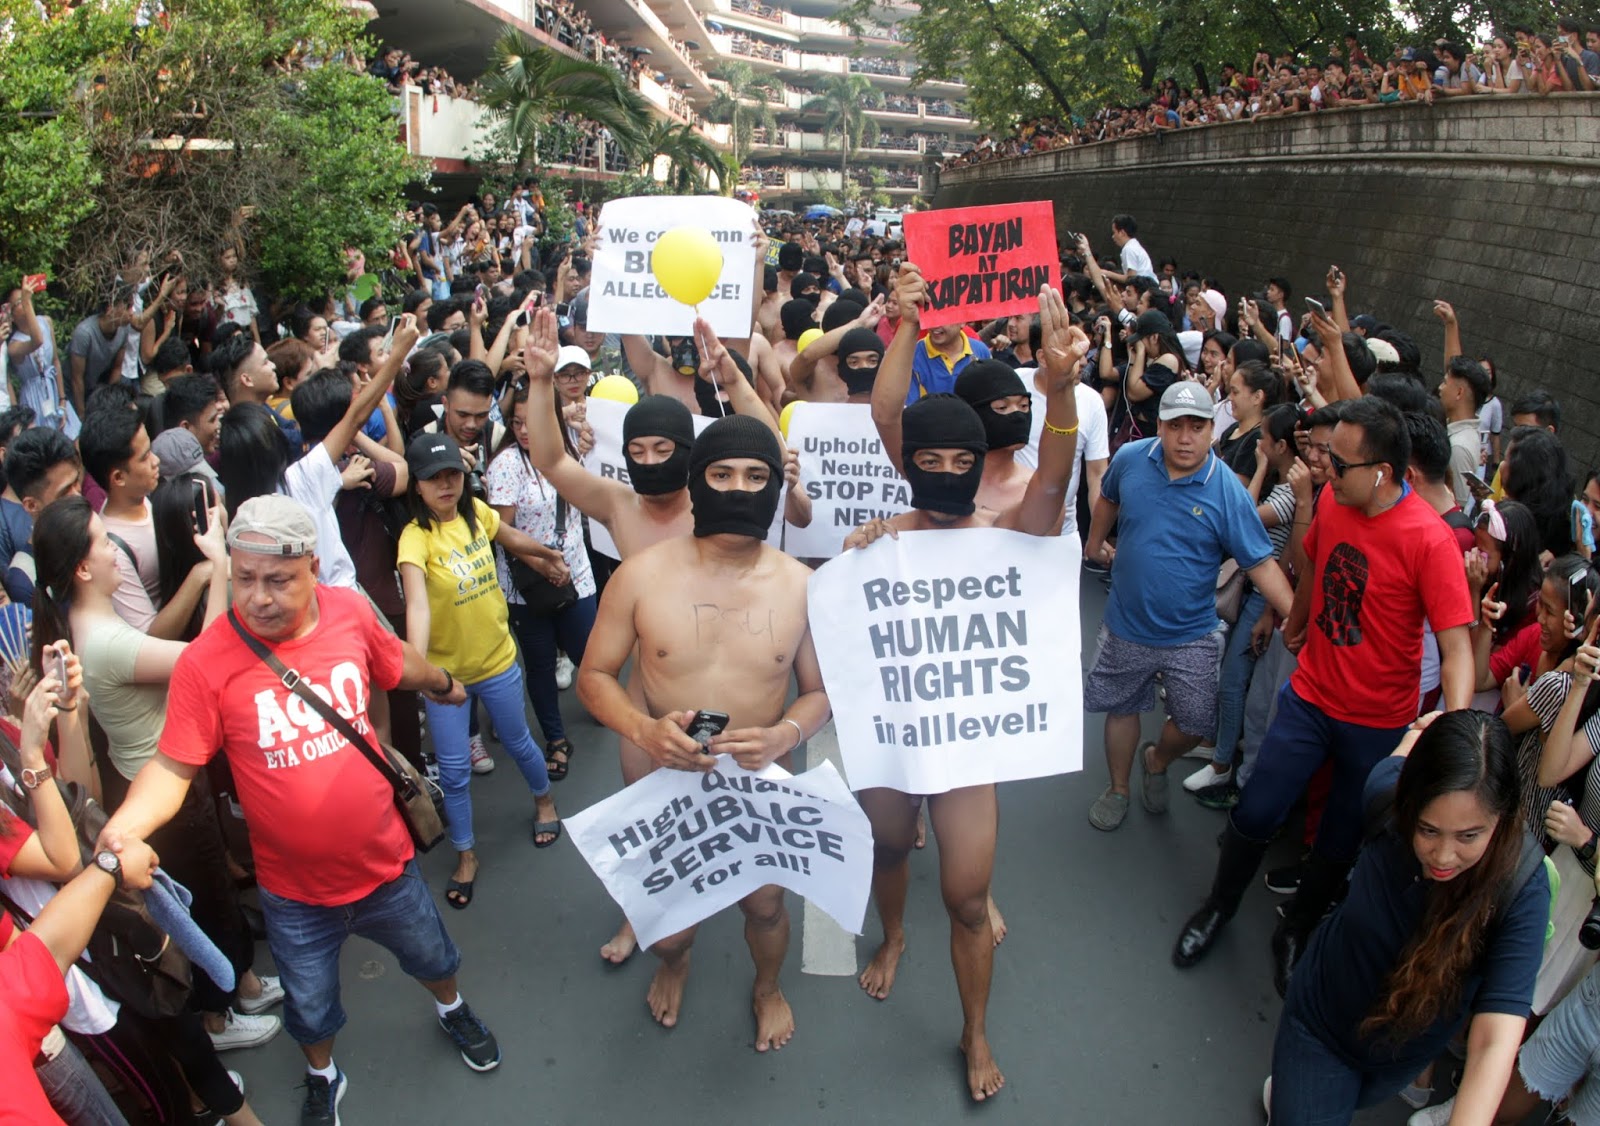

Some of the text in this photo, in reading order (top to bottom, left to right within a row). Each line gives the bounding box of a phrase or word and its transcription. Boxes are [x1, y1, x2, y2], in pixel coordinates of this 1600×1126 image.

[609, 228, 743, 244] We comn
[948, 217, 1023, 258] BAYAN
[978, 254, 998, 272] AT
[602, 280, 741, 300] ALLEGCE!
[924, 265, 1049, 312] KAPATIRAN
[804, 437, 880, 456] Uphold
[806, 481, 909, 506] STOP FA
[834, 507, 902, 527] NEW
[863, 567, 1021, 612] Respect
[868, 609, 1028, 659] HUMAN
[880, 655, 1031, 703] RIGHTS
[264, 715, 369, 769] ETA OMICN
[873, 702, 1048, 747] in all level!
[608, 795, 694, 858] High
[649, 795, 823, 865] PUBLIC
[642, 823, 845, 896] SERVICE
[690, 851, 811, 894] for all!
